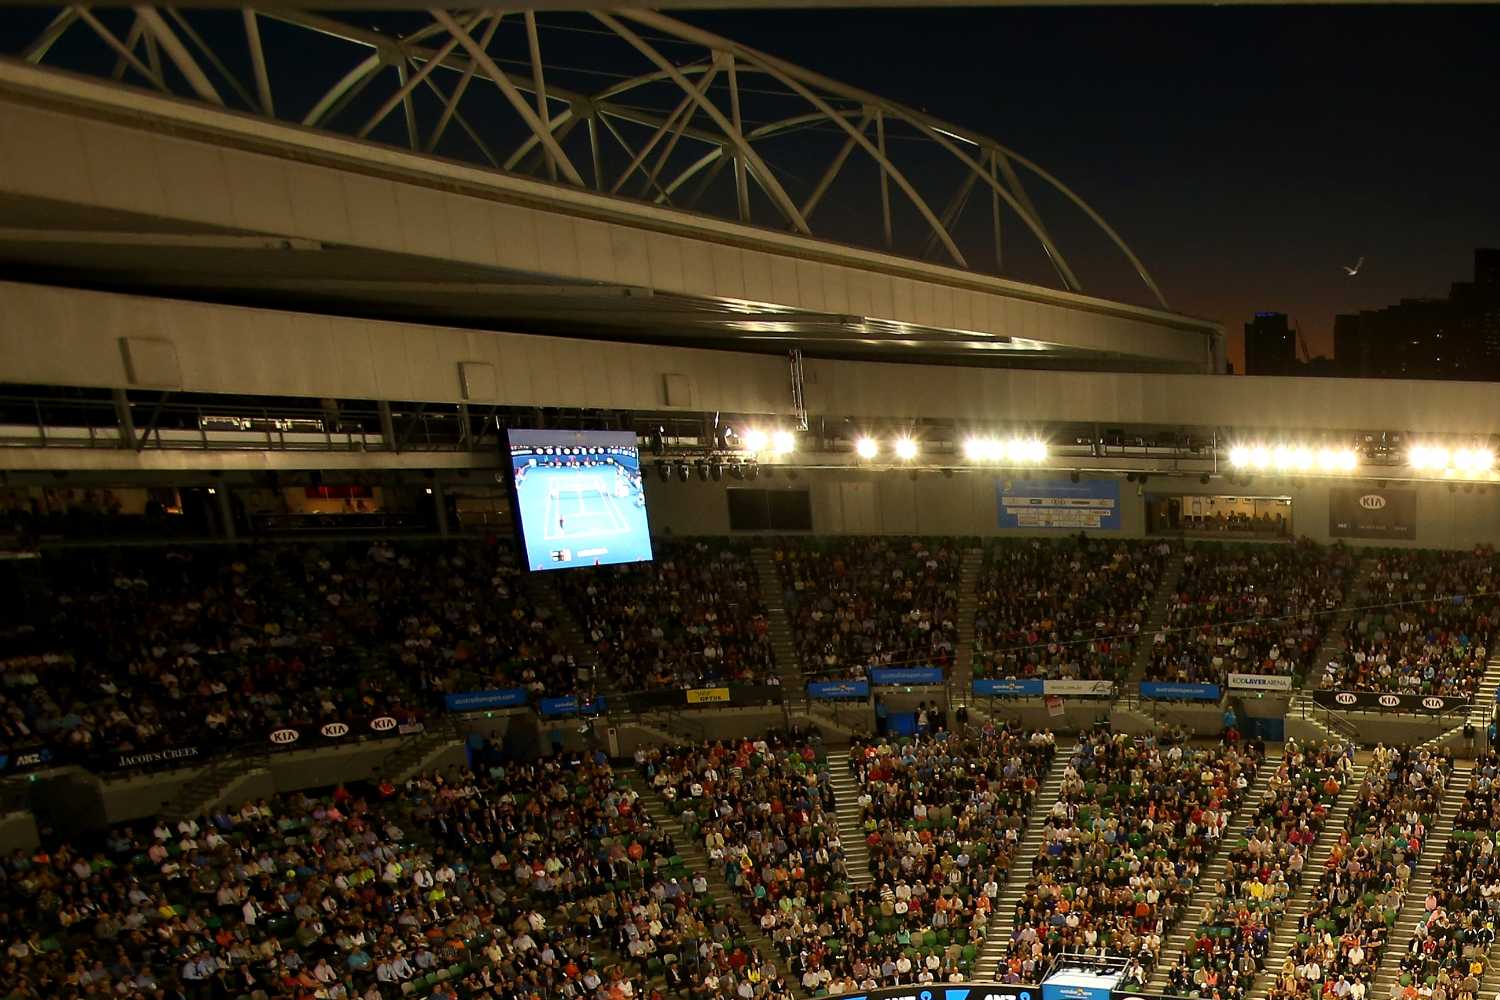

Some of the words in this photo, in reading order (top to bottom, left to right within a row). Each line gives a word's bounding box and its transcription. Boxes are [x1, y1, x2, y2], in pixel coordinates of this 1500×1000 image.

[1363, 497, 1382, 507] KIA
[374, 719, 394, 728] KIA
[326, 725, 346, 735] KIA
[274, 732, 295, 741] KIA
